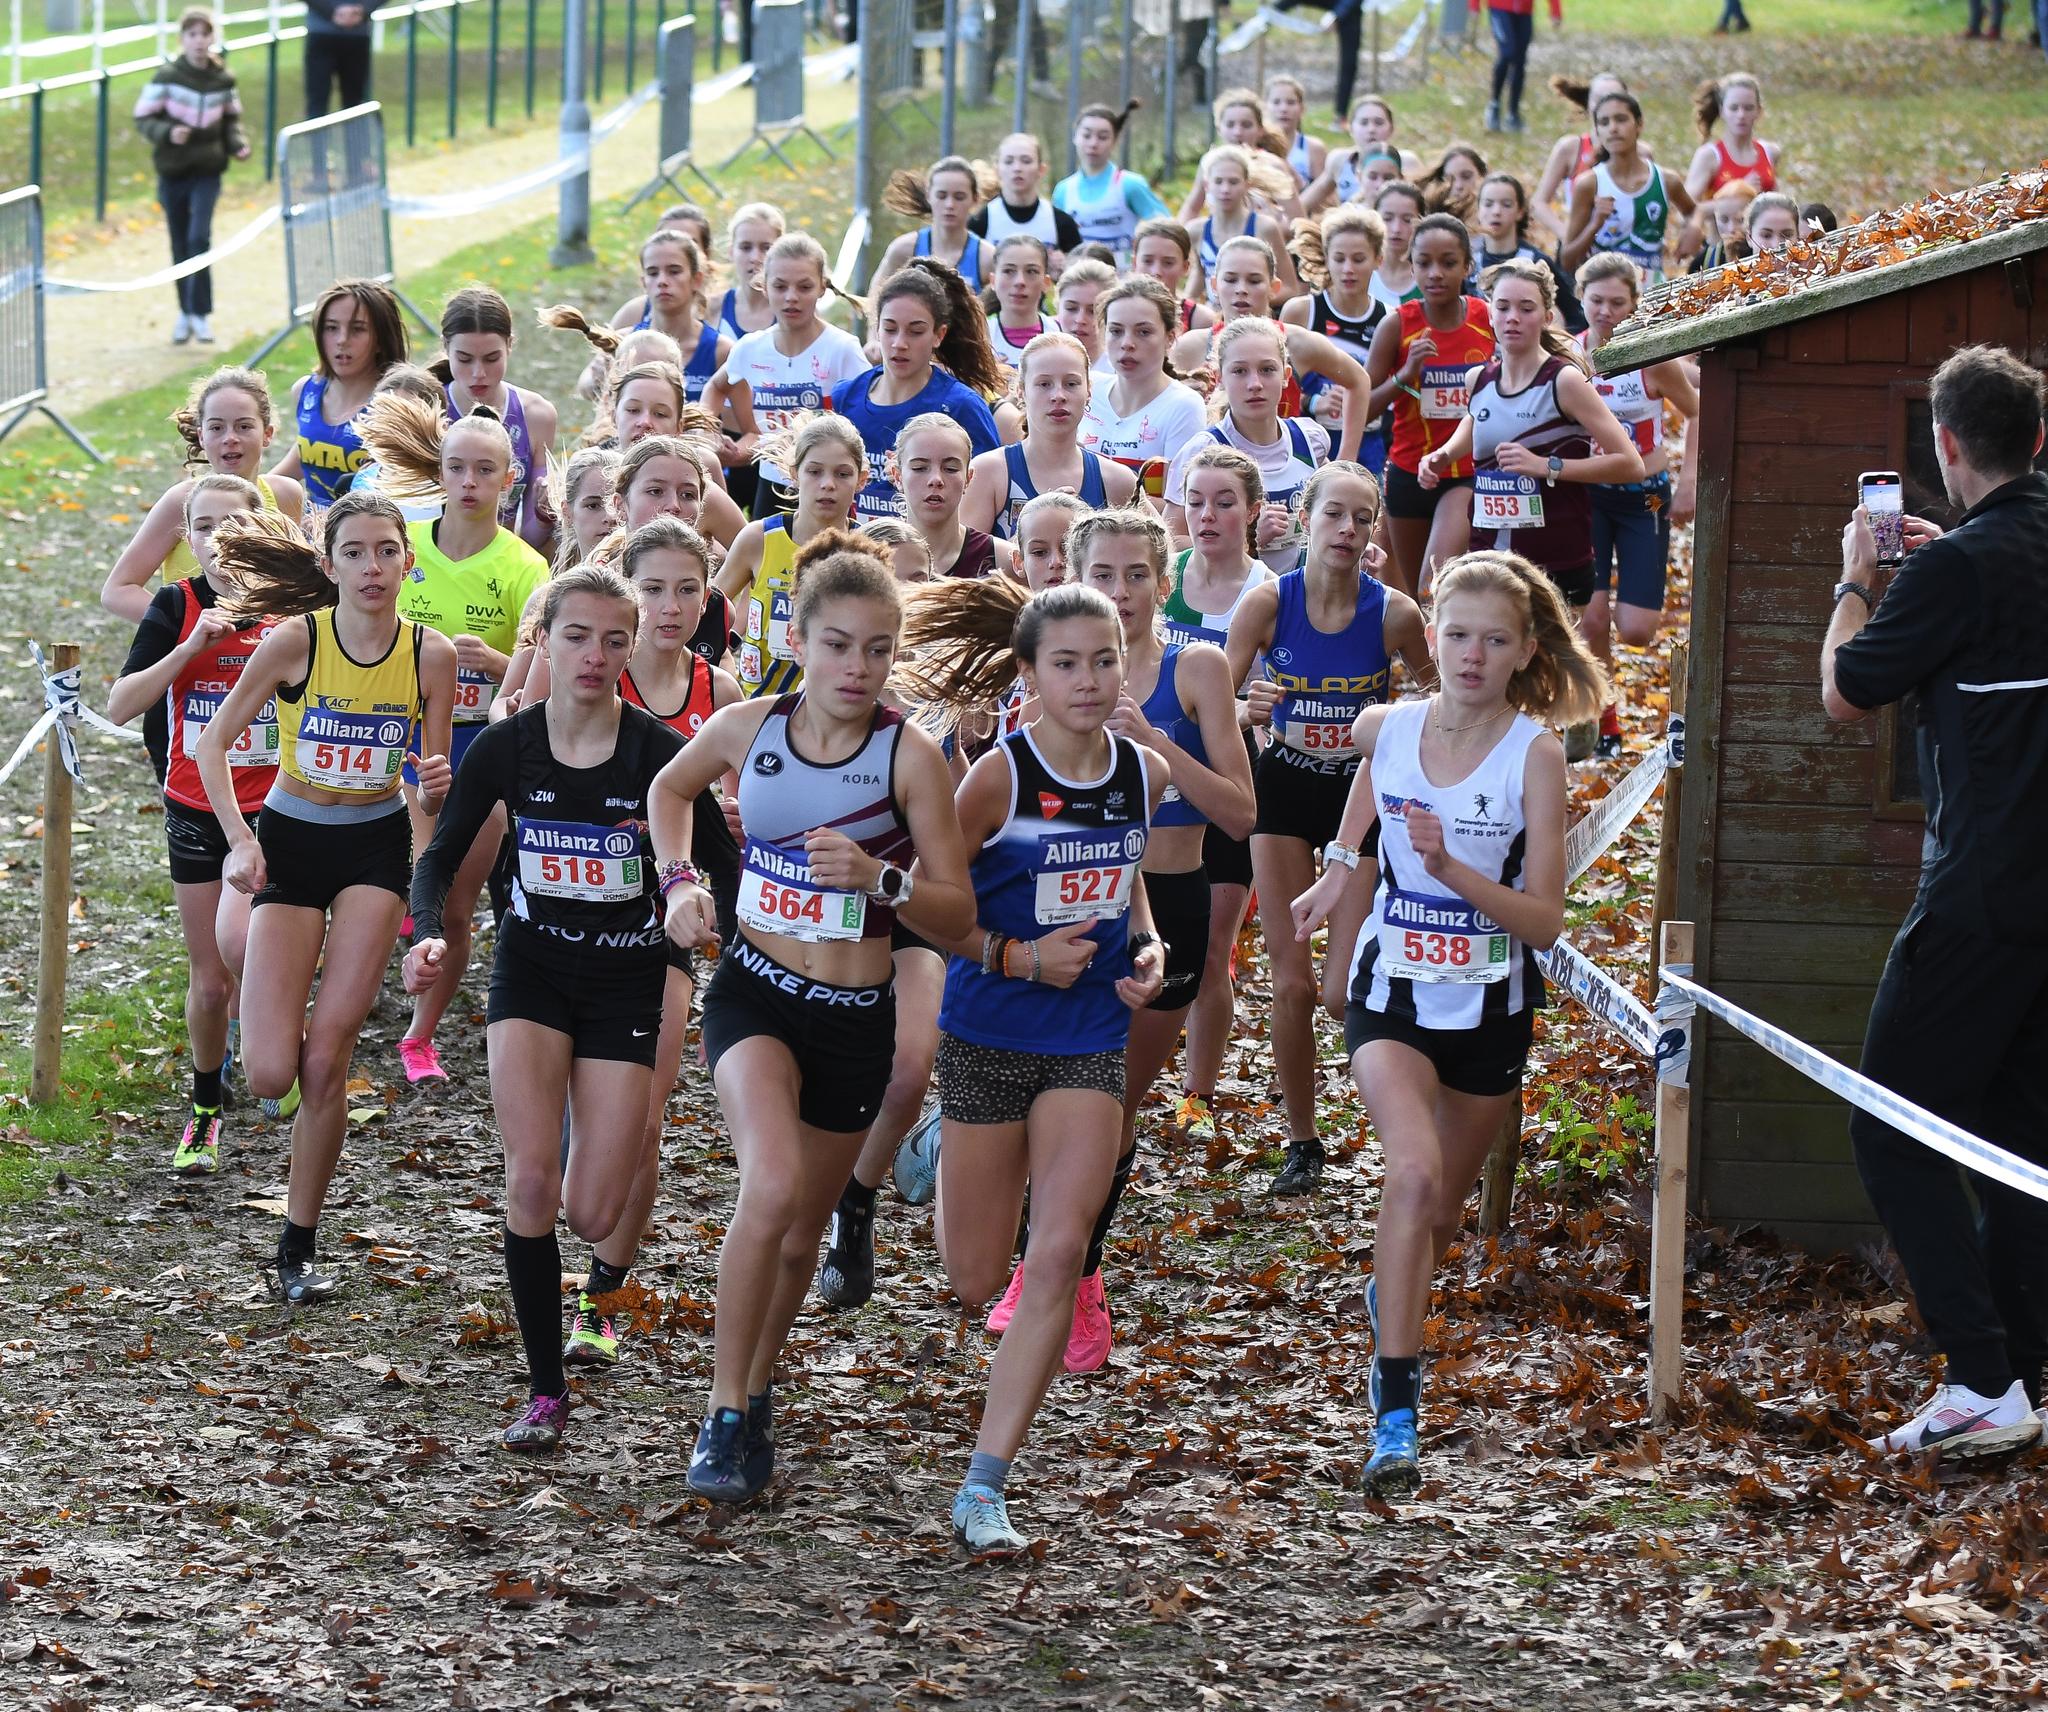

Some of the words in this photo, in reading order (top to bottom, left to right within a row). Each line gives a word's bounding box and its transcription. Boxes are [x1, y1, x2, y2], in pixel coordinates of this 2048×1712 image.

[754, 392, 800, 406] Allianz
[1475, 475, 1516, 491] Allianz
[1483, 496, 1519, 516] 553
[187, 698, 221, 717] Alli
[328, 698, 354, 708] ACT
[1291, 699, 1356, 719] Allianz
[304, 715, 375, 740] Allianz
[1303, 725, 1355, 749] 532
[314, 743, 373, 774] 514
[388, 750, 401, 773] 2024
[1275, 746, 1340, 776] NIKE
[842, 774, 881, 785] ROBA
[523, 828, 600, 852] Allianz
[748, 845, 817, 884] Allian
[1044, 840, 1121, 866] Allianz
[541, 855, 606, 886] 518
[627, 860, 638, 882] 2024
[1059, 867, 1123, 905] 527
[758, 879, 824, 924] 564
[1387, 897, 1469, 929] Allianz
[595, 926, 664, 948] NIKE
[1403, 930, 1471, 966] 538
[734, 943, 805, 996] NIKE
[804, 983, 880, 1007] PRO
